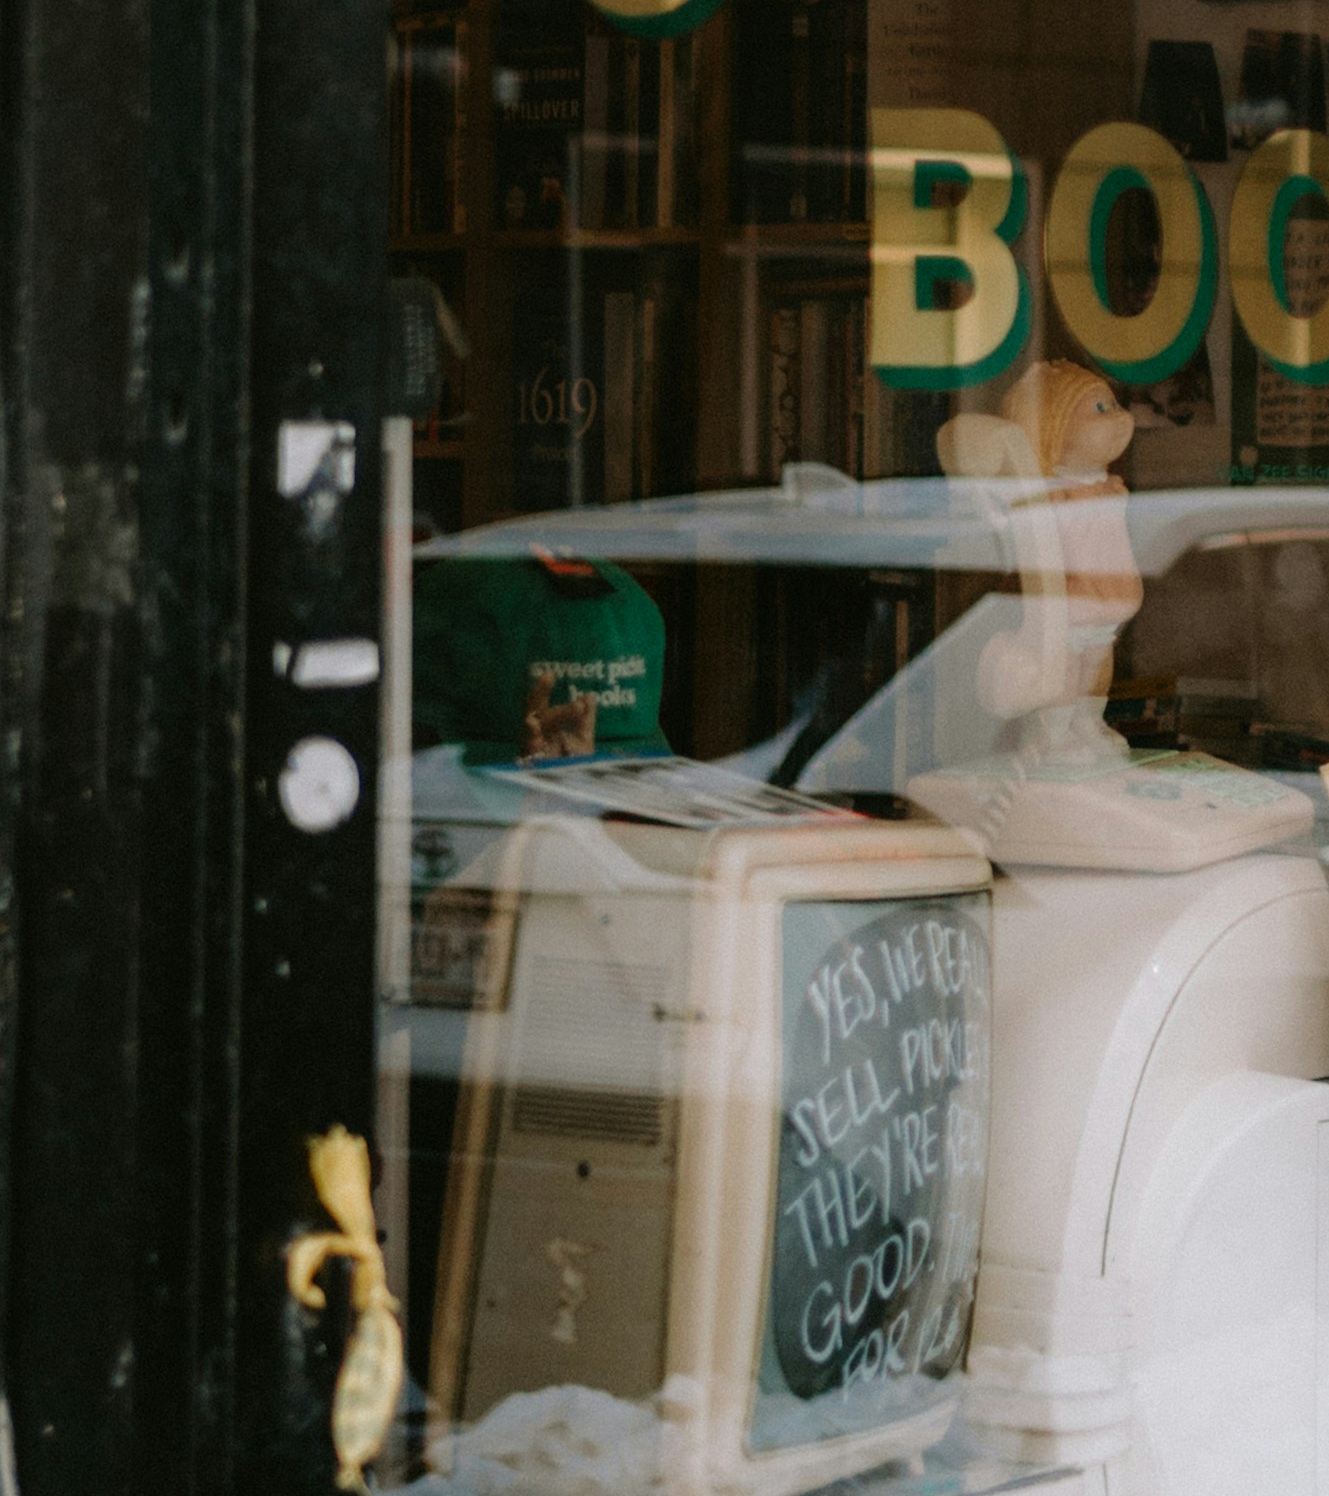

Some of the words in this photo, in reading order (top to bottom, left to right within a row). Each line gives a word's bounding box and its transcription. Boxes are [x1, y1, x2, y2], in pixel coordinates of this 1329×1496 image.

[517, 364, 597, 439] 1619
[808, 945, 891, 1064] YES,
[880, 925, 926, 1004] WE
[792, 1059, 901, 1168] SELL
[784, 1105, 940, 1270] THEY'RE
[800, 1216, 936, 1364] GOOD.
[842, 1308, 911, 1404] FOR
